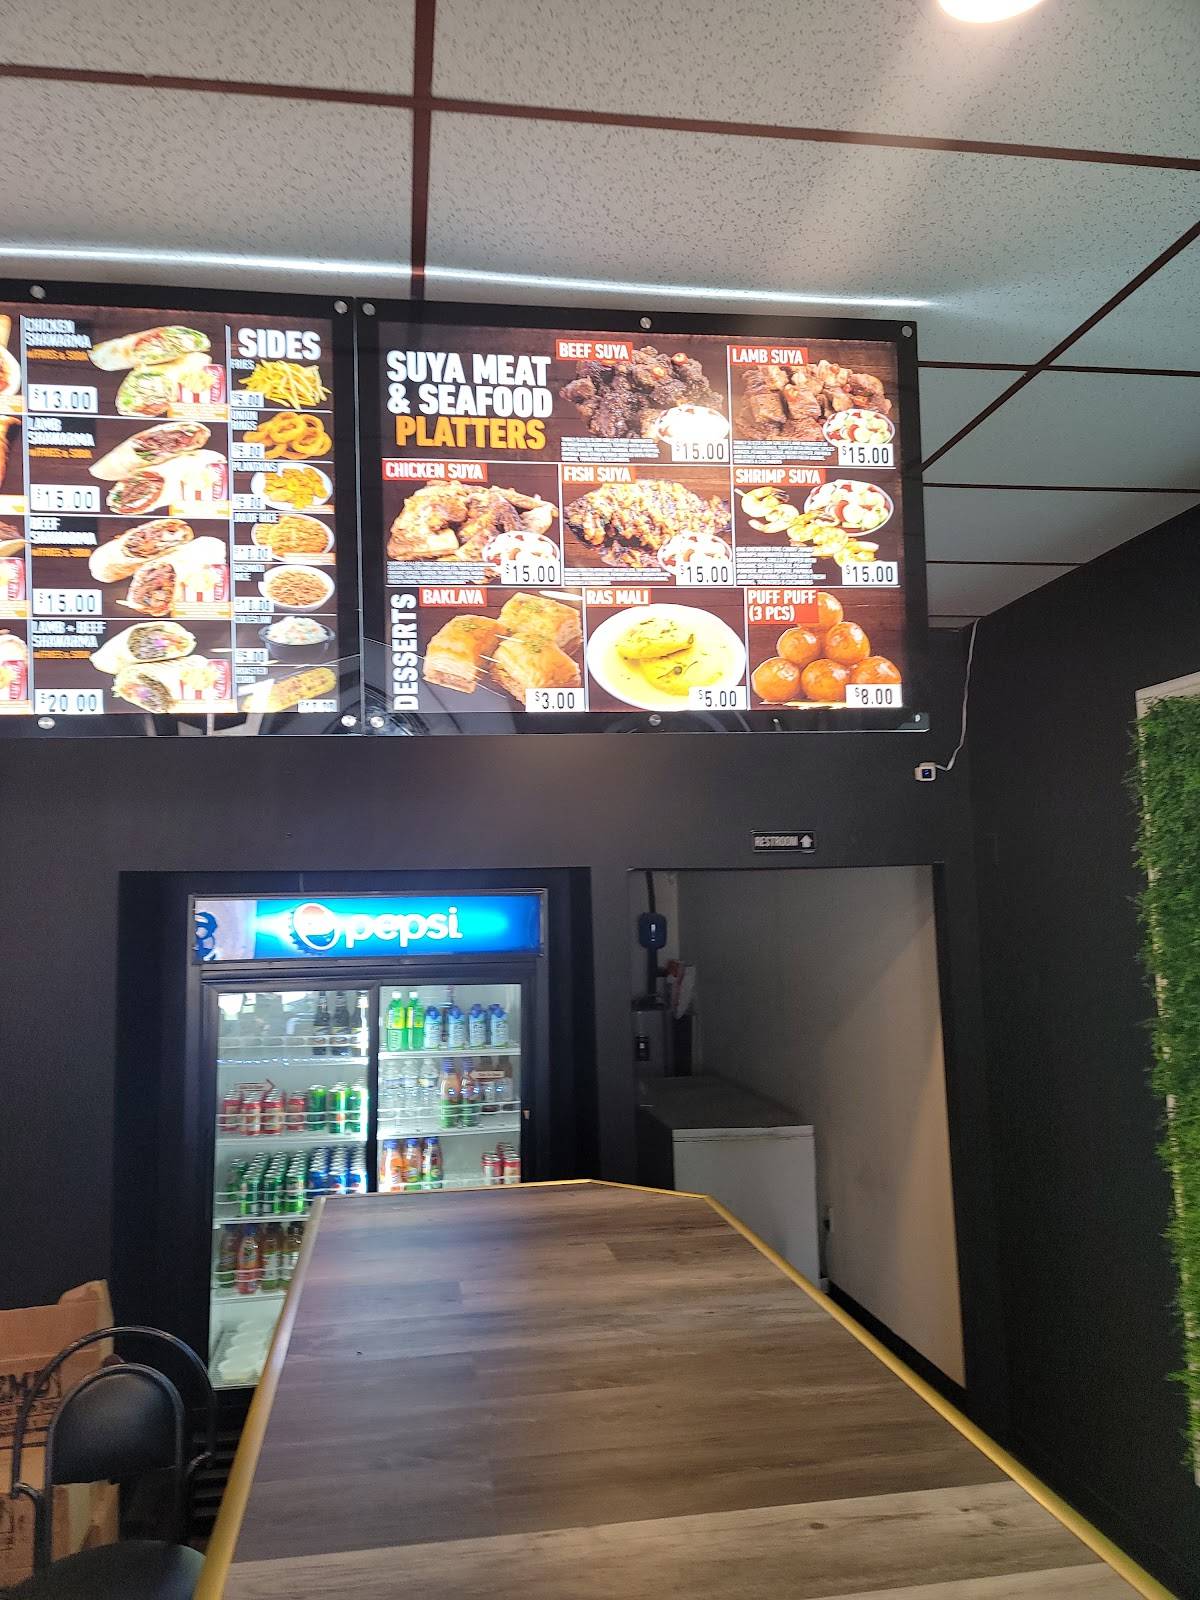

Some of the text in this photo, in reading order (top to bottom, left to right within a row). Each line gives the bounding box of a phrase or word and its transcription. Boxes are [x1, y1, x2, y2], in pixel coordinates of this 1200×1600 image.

[237, 327, 321, 360] SIDES
[559, 343, 629, 360] BEEF SUYA
[732, 349, 803, 364] LAMB SUYA
[386, 350, 551, 386] SUYA MEAT
[33, 388, 91, 409] $13.00
[387, 382, 553, 418] & SEAFOOD
[395, 415, 546, 449] PLATTERS
[675, 441, 725, 460] $15.00
[842, 446, 889, 464] $15.00
[386, 462, 483, 479] CHICKEN SUYA
[564, 466, 632, 482] FISH SUYA
[736, 469, 820, 484] SHRIMP SUYA
[36, 488, 93, 509] $15.00
[506, 563, 556, 583] $15.00
[681, 565, 729, 583] $15.00
[846, 566, 894, 583] $15.00
[39, 592, 96, 612] $15.00
[422, 589, 485, 605] BAKLAVA
[586, 590, 649, 606] RAS MALI
[748, 590, 816, 605] PUFF PUFF
[748, 605, 795, 622] (3 PCS)
[390, 594, 419, 711] DESSERTS
[41, 693, 97, 712] $20.00
[535, 691, 575, 709] $3.00
[698, 690, 737, 707] $5.00
[855, 687, 893, 705] $8.00
[346, 906, 464, 949] pepsi
